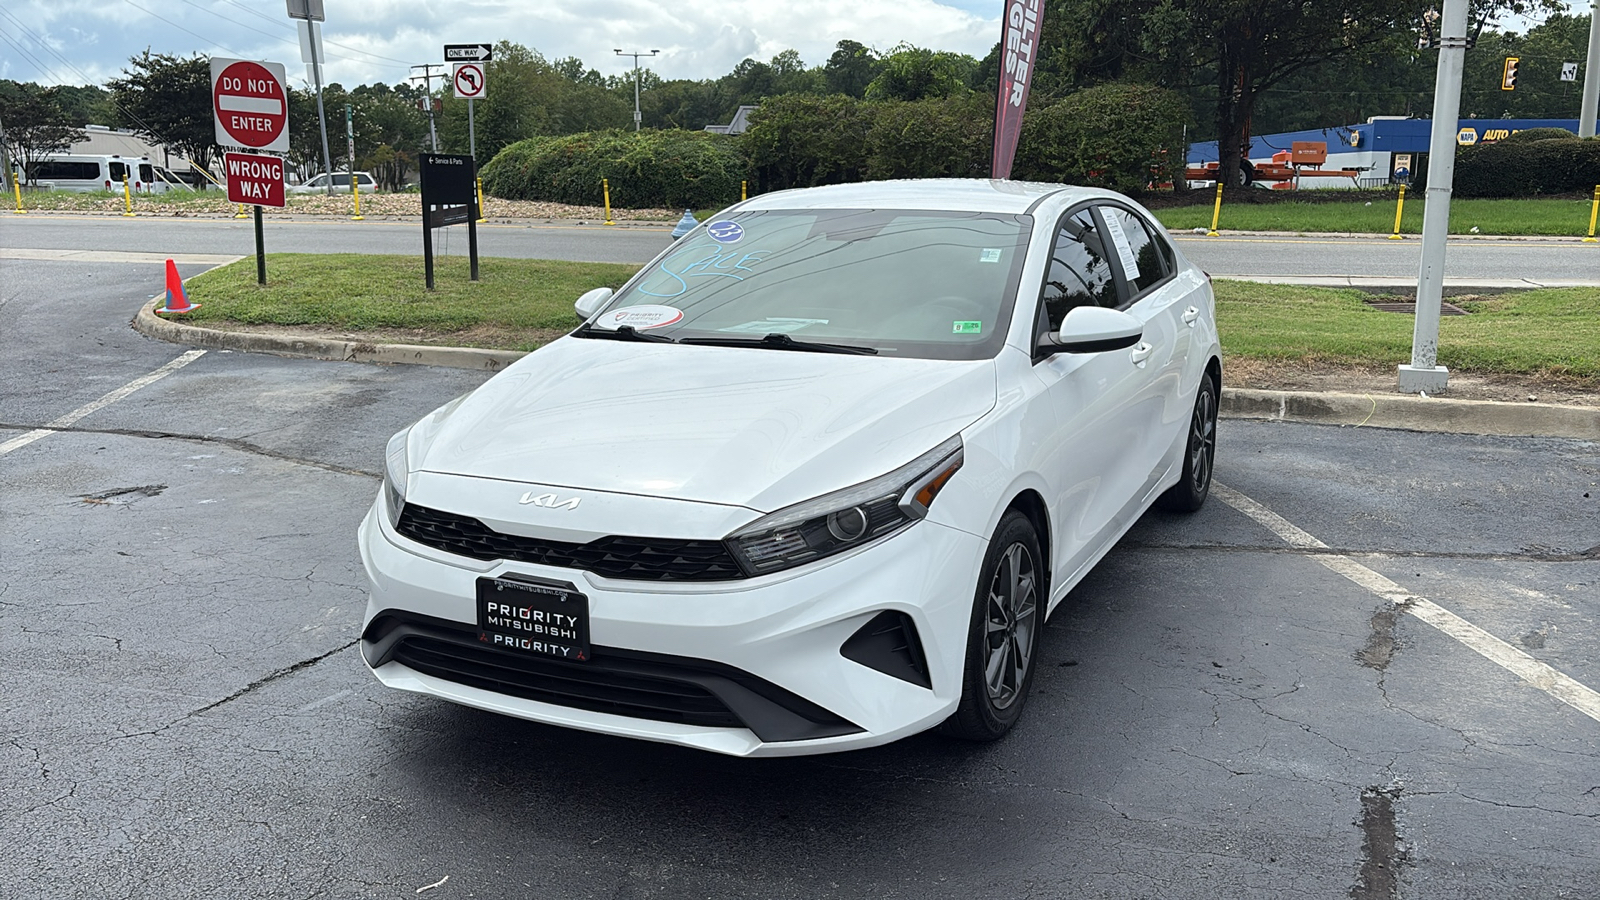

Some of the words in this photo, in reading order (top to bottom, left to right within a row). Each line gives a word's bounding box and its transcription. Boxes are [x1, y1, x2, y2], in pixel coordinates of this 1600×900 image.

[1005, 0, 1025, 75] GES
[223, 77, 241, 91] DO
[247, 78, 274, 94] NOT
[231, 115, 273, 132] ENTER
[1460, 132, 1475, 141] NAPA
[1482, 129, 1509, 140] AUTO
[229, 160, 281, 180] WRONG
[435, 157, 449, 165] Service
[240, 181, 271, 199] WAY
[638, 243, 772, 297] SALE
[519, 491, 581, 511] KIA
[487, 601, 578, 627] PRIORITY
[487, 615, 577, 640] MITSUBISHI
[494, 634, 571, 657] PRIORITY
